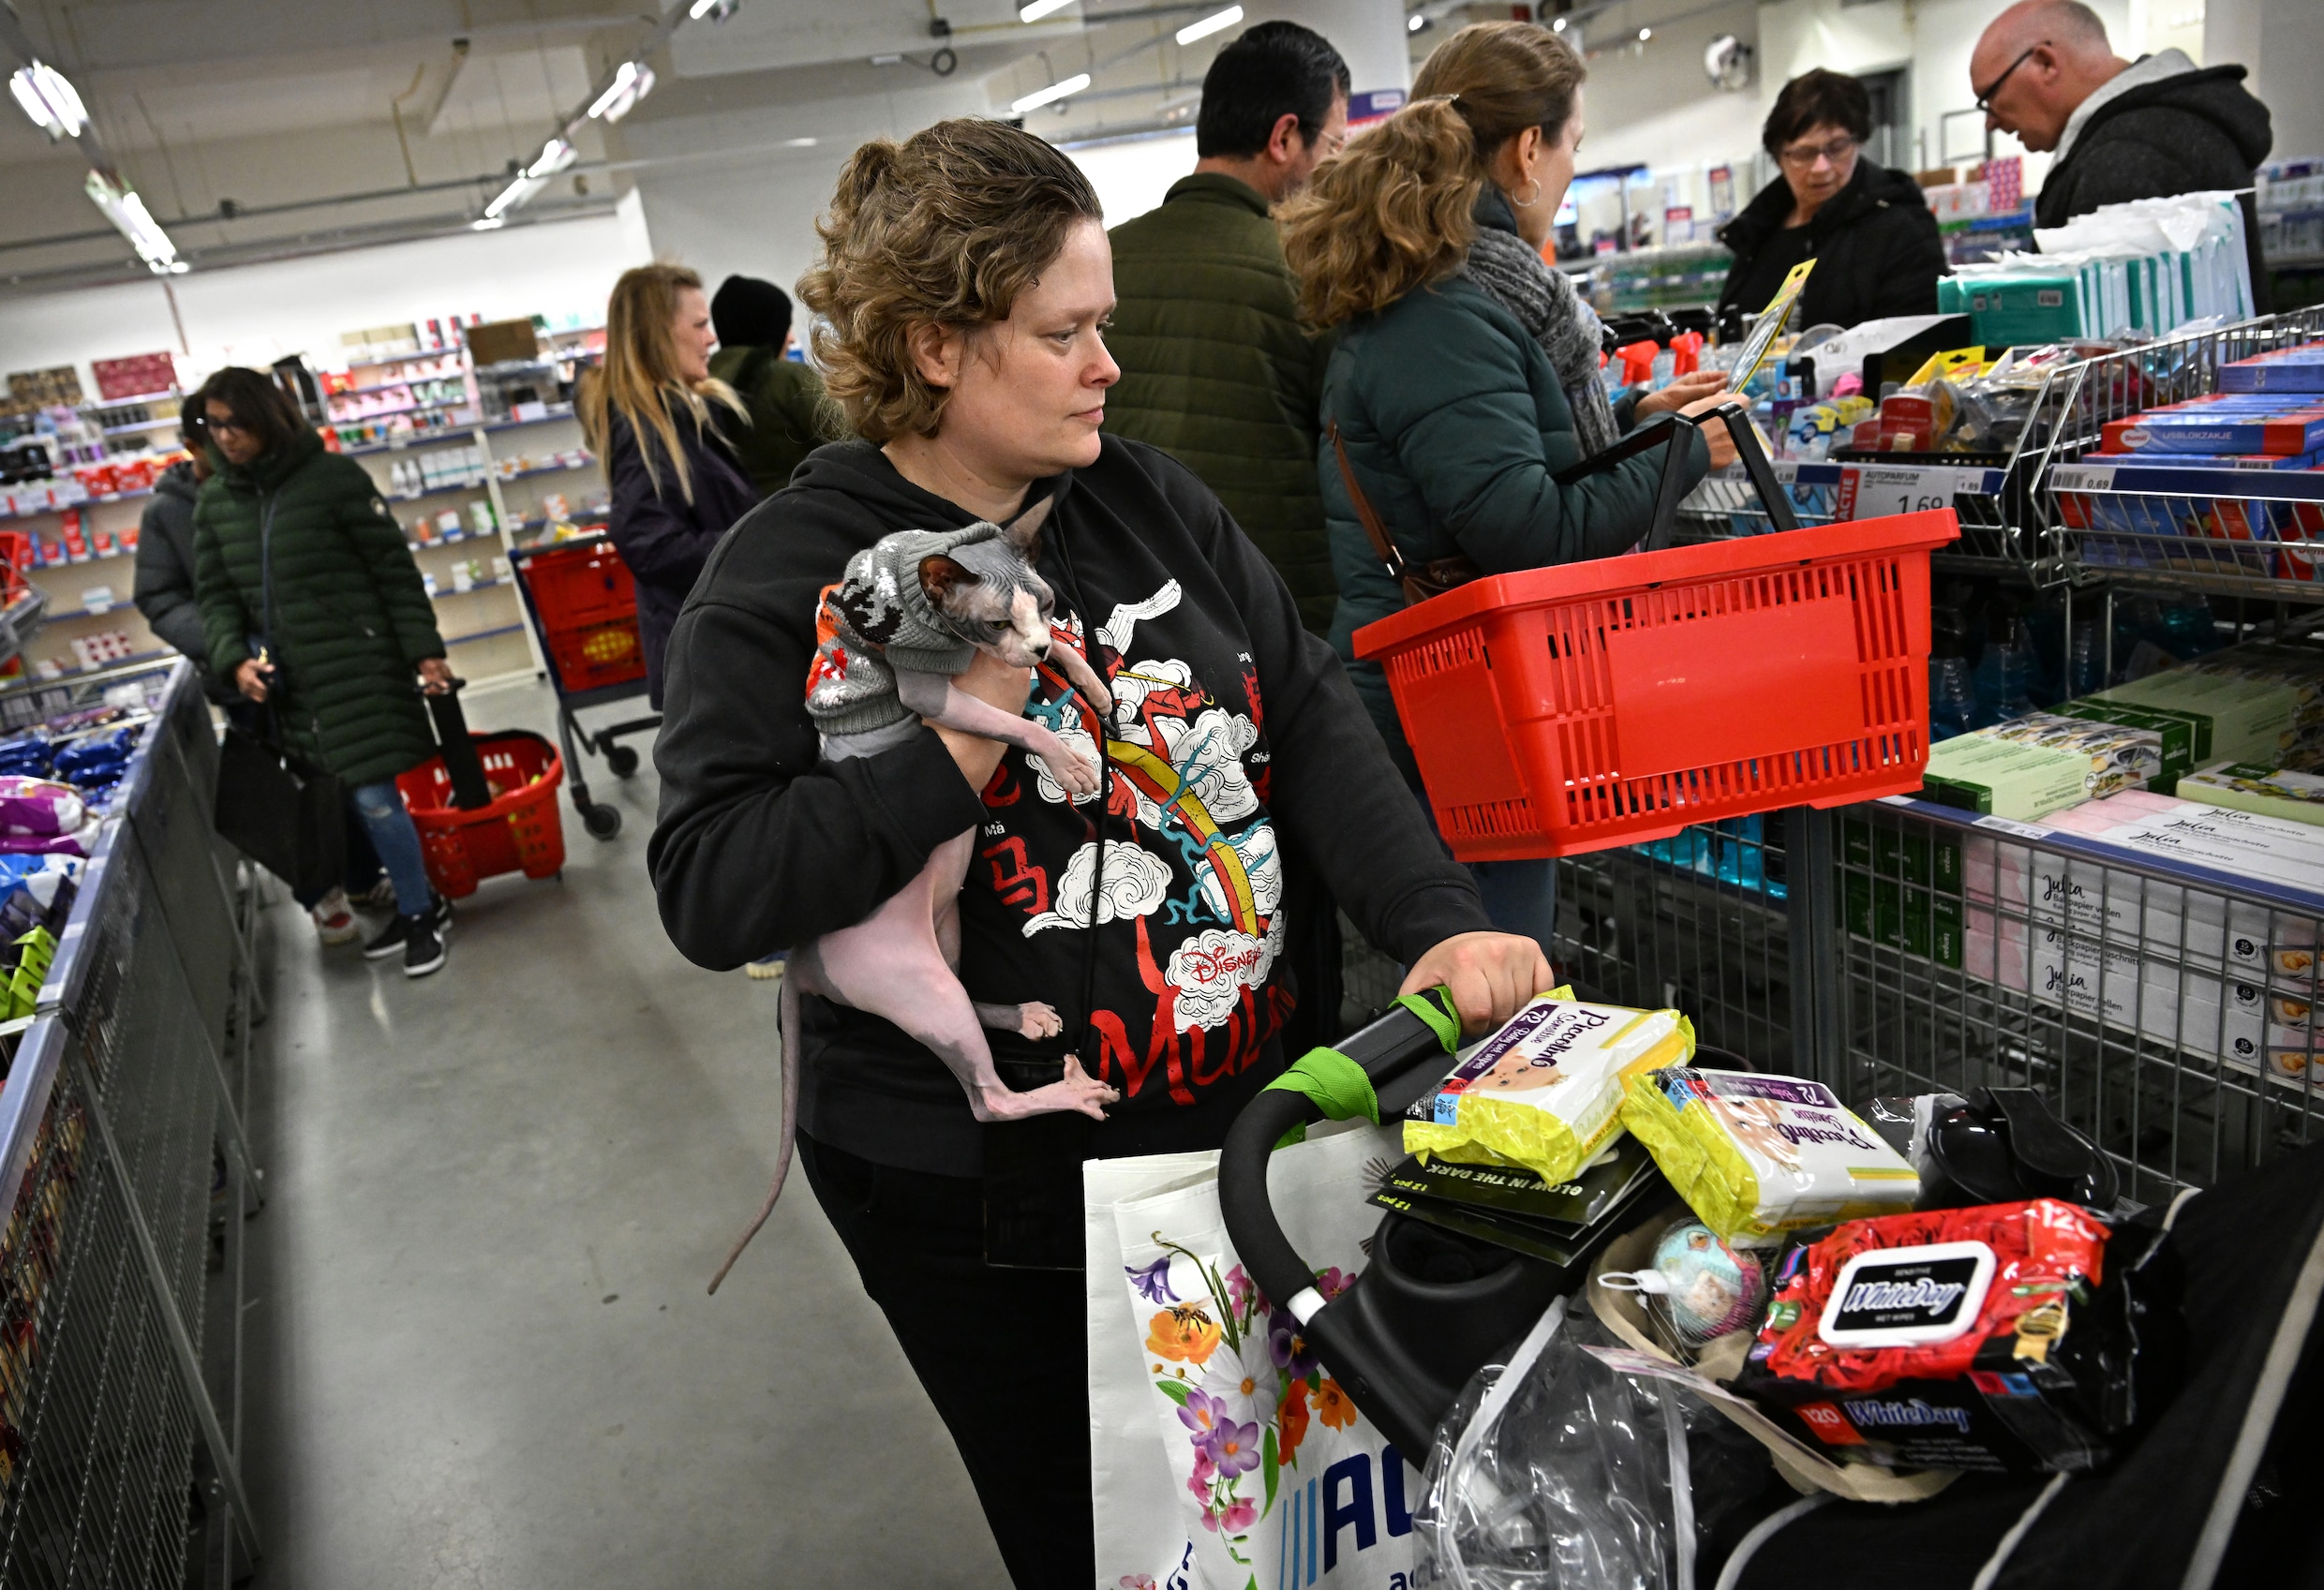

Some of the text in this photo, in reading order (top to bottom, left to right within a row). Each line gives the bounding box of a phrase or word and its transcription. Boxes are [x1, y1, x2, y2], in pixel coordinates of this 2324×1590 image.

[1865, 469, 1920, 483] AUTOPARFUM
[1838, 477, 1855, 521] ACTIE
[2128, 830, 2182, 844] Julia
[982, 835, 1050, 916] 马
[2042, 873, 2086, 901] Julia
[2053, 893, 2095, 912] Bapapier
[2046, 964, 2089, 990] Juia
[1520, 1007, 1549, 1025] 72
[1501, 1025, 1530, 1048] Baby
[1530, 1012, 1577, 1045] Sensitive
[1795, 1085, 1825, 1106] 72
[1791, 1108, 1844, 1132] Sensitive
[1426, 1163, 1472, 1181] DARK
[1472, 1172, 1507, 1186] THE
[1508, 1175, 1531, 1189] IN
[1393, 1179, 1428, 1193] 12 pcs
[1377, 1194, 1412, 1211] 12 pcs
[1842, 1277, 1967, 1317] WhiteDay
[1801, 1407, 1840, 1424] 120
[1844, 1398, 1971, 1434] WhiteDay
